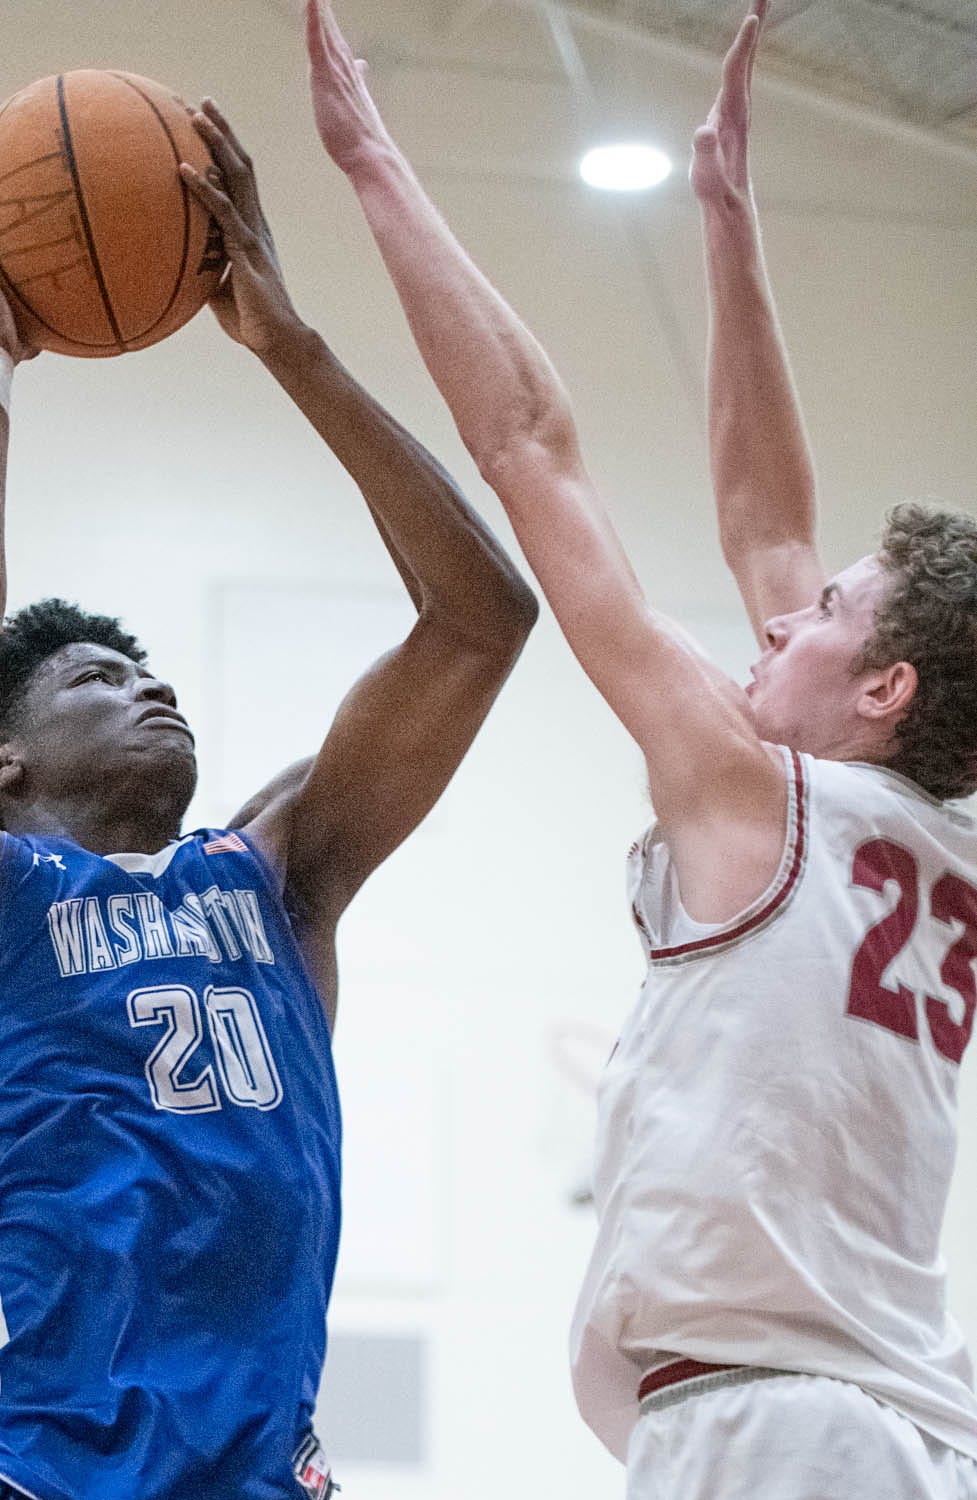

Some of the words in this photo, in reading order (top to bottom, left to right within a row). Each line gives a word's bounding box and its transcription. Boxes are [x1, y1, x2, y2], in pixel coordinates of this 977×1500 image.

[47, 885, 275, 978] WASHNTN
[845, 835, 977, 1066] 23
[126, 983, 283, 1115] 20
